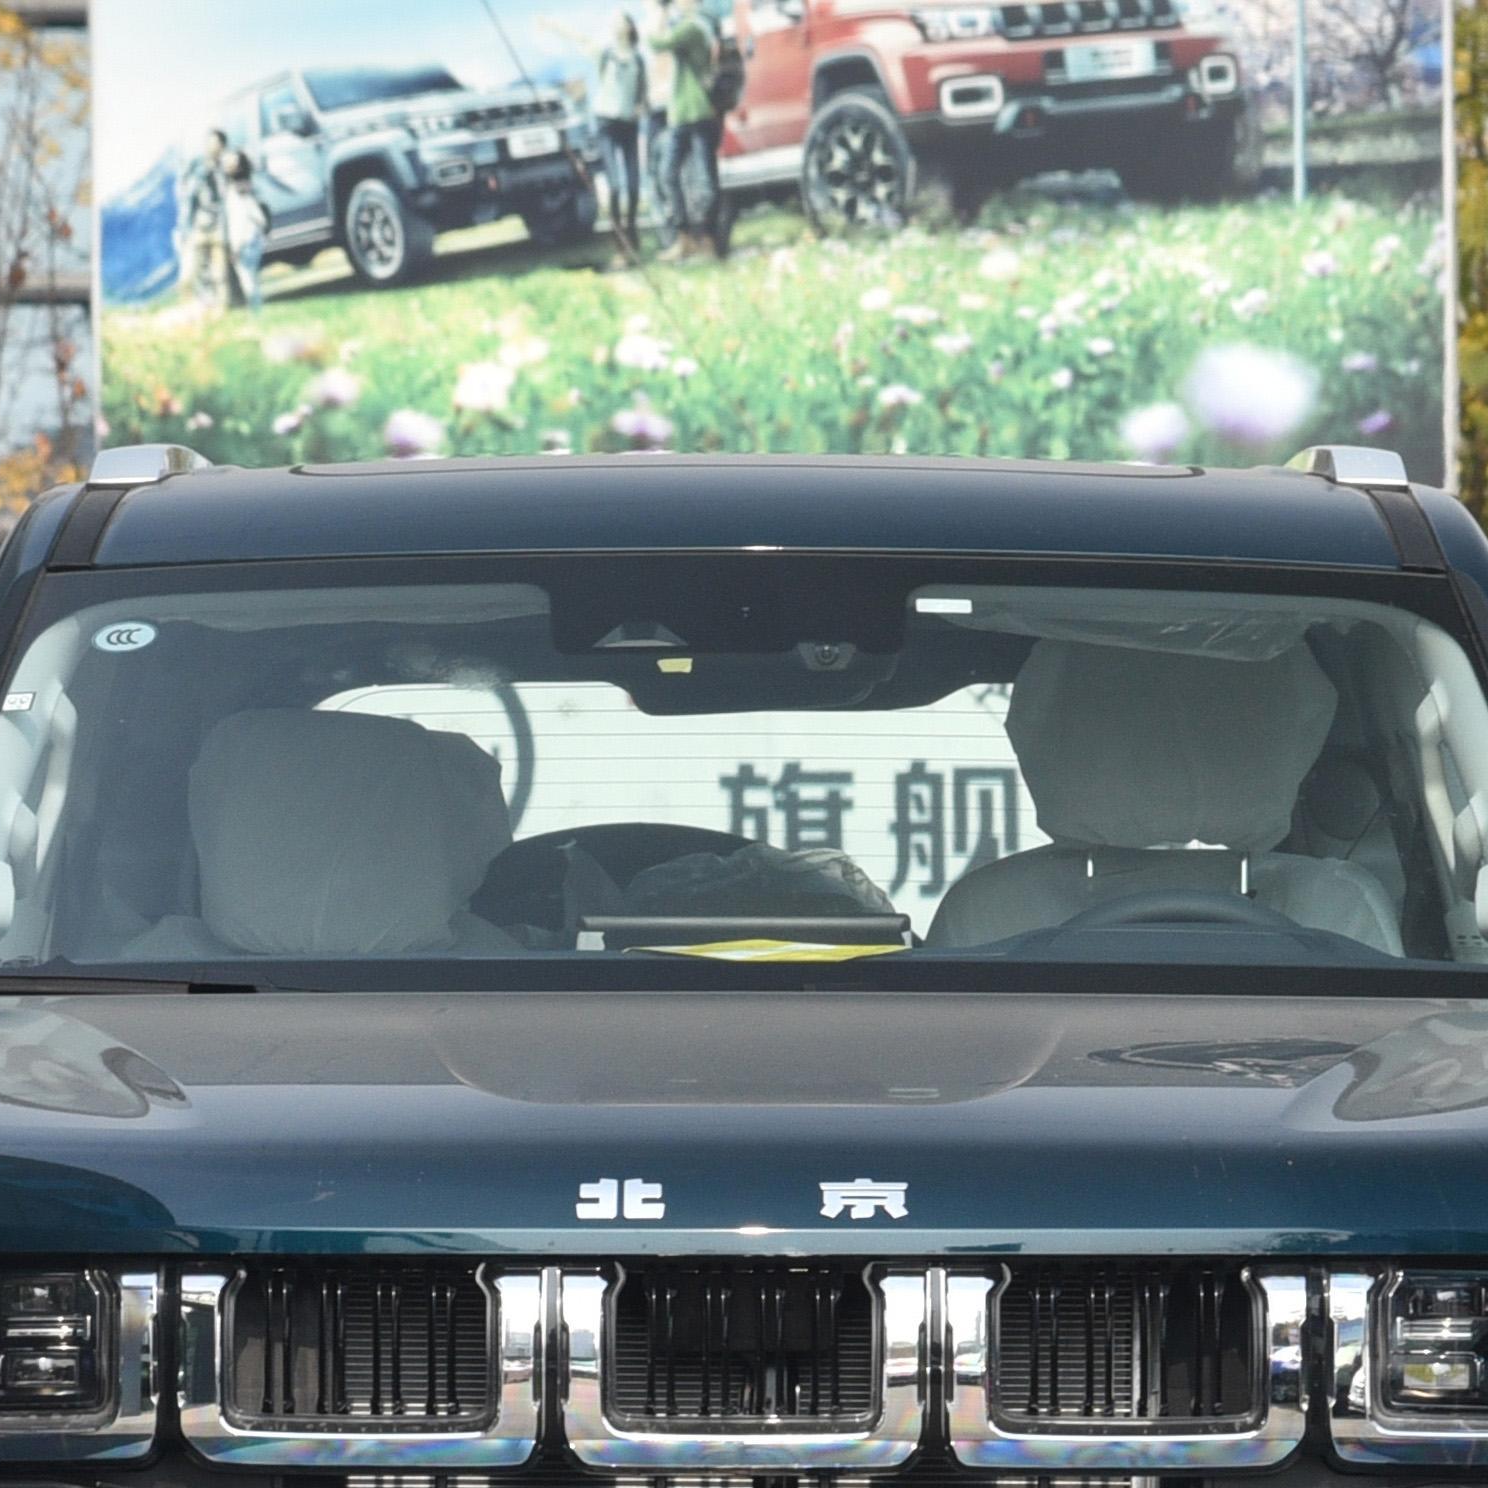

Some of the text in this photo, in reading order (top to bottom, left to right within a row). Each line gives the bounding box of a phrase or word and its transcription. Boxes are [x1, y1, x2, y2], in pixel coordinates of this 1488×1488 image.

[106, 628, 142, 646] CCC
[719, 759, 1019, 898] 旗舰
[575, 1178, 909, 1219] 北京
